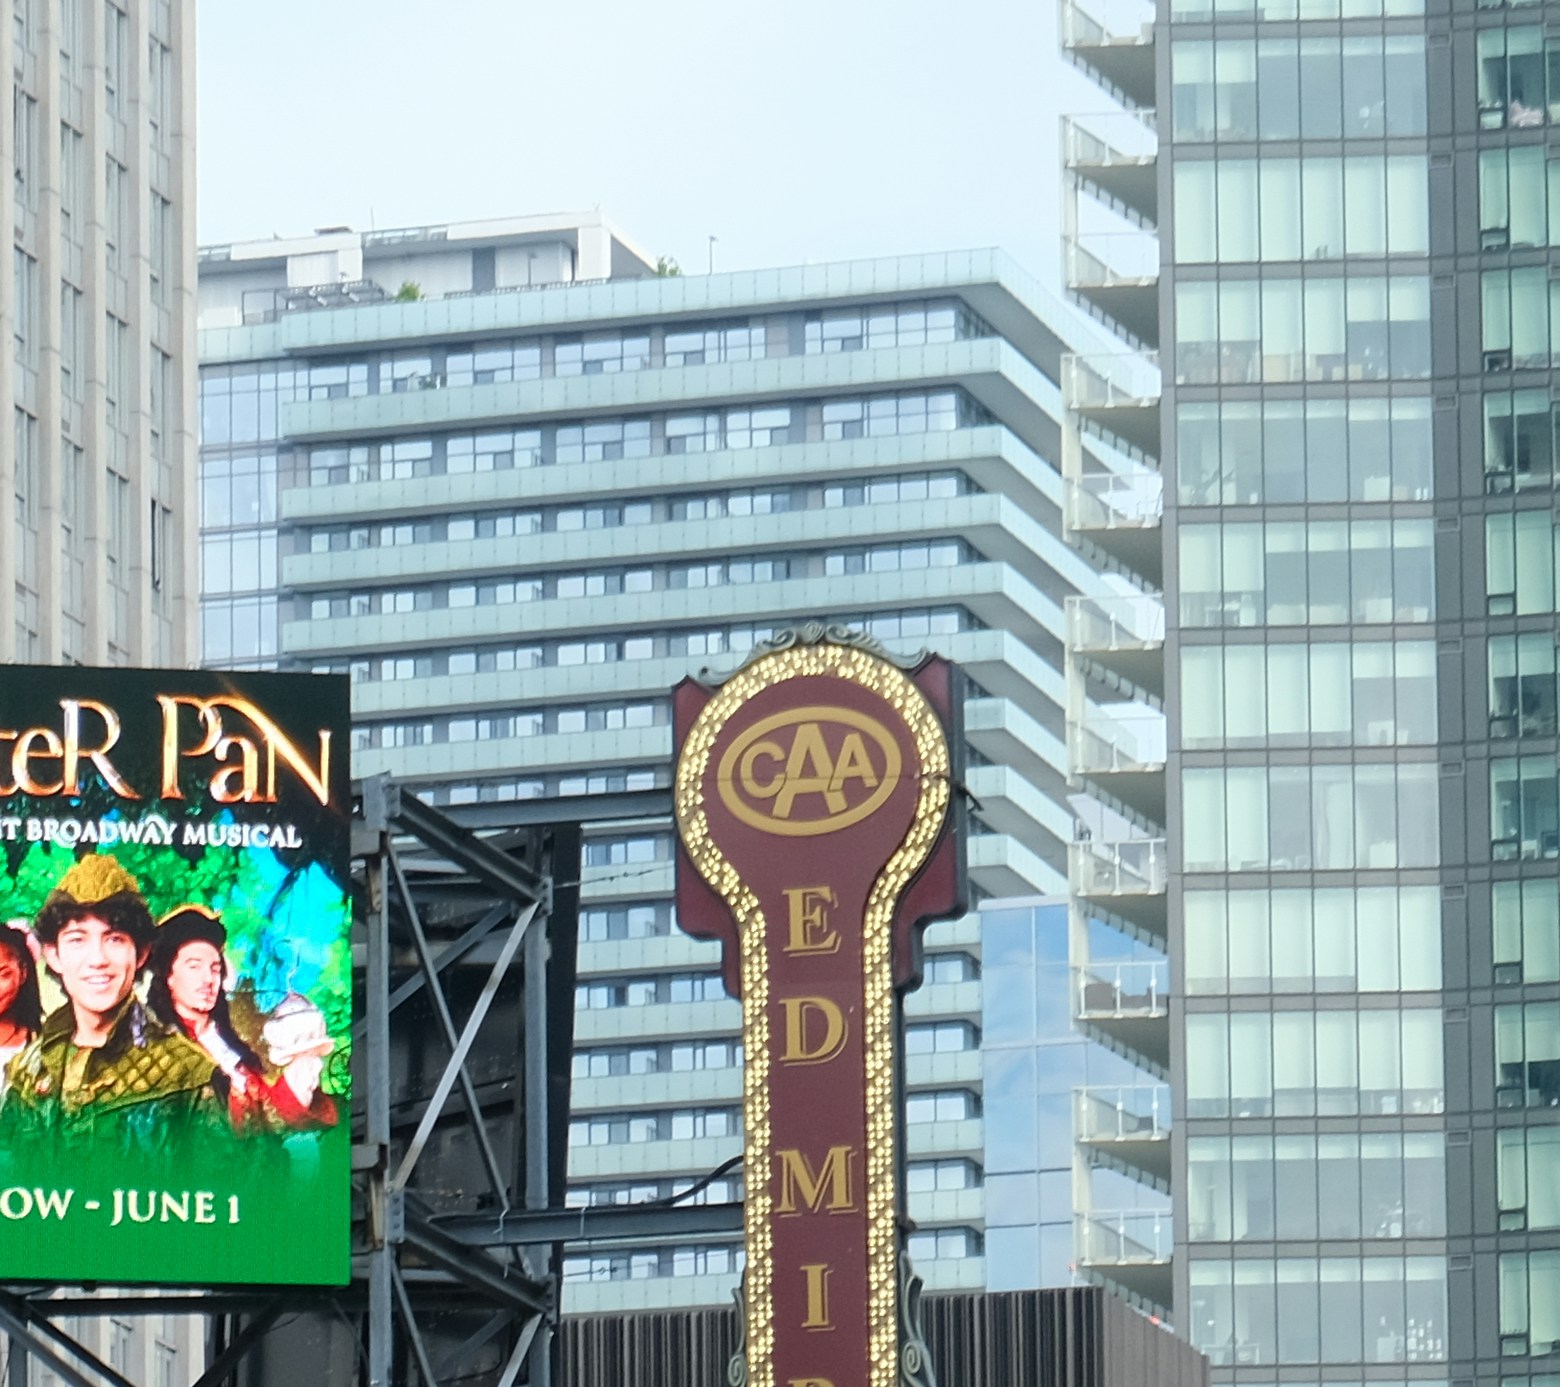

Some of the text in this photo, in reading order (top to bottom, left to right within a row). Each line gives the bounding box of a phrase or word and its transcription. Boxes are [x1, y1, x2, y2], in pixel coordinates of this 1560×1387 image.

[740, 723, 879, 818] CAA
[26, 820, 176, 846] BROADWAY
[182, 823, 302, 849] MUSICAL
[109, 1190, 218, 1225] JUNE
[228, 1192, 241, 1223] 1
